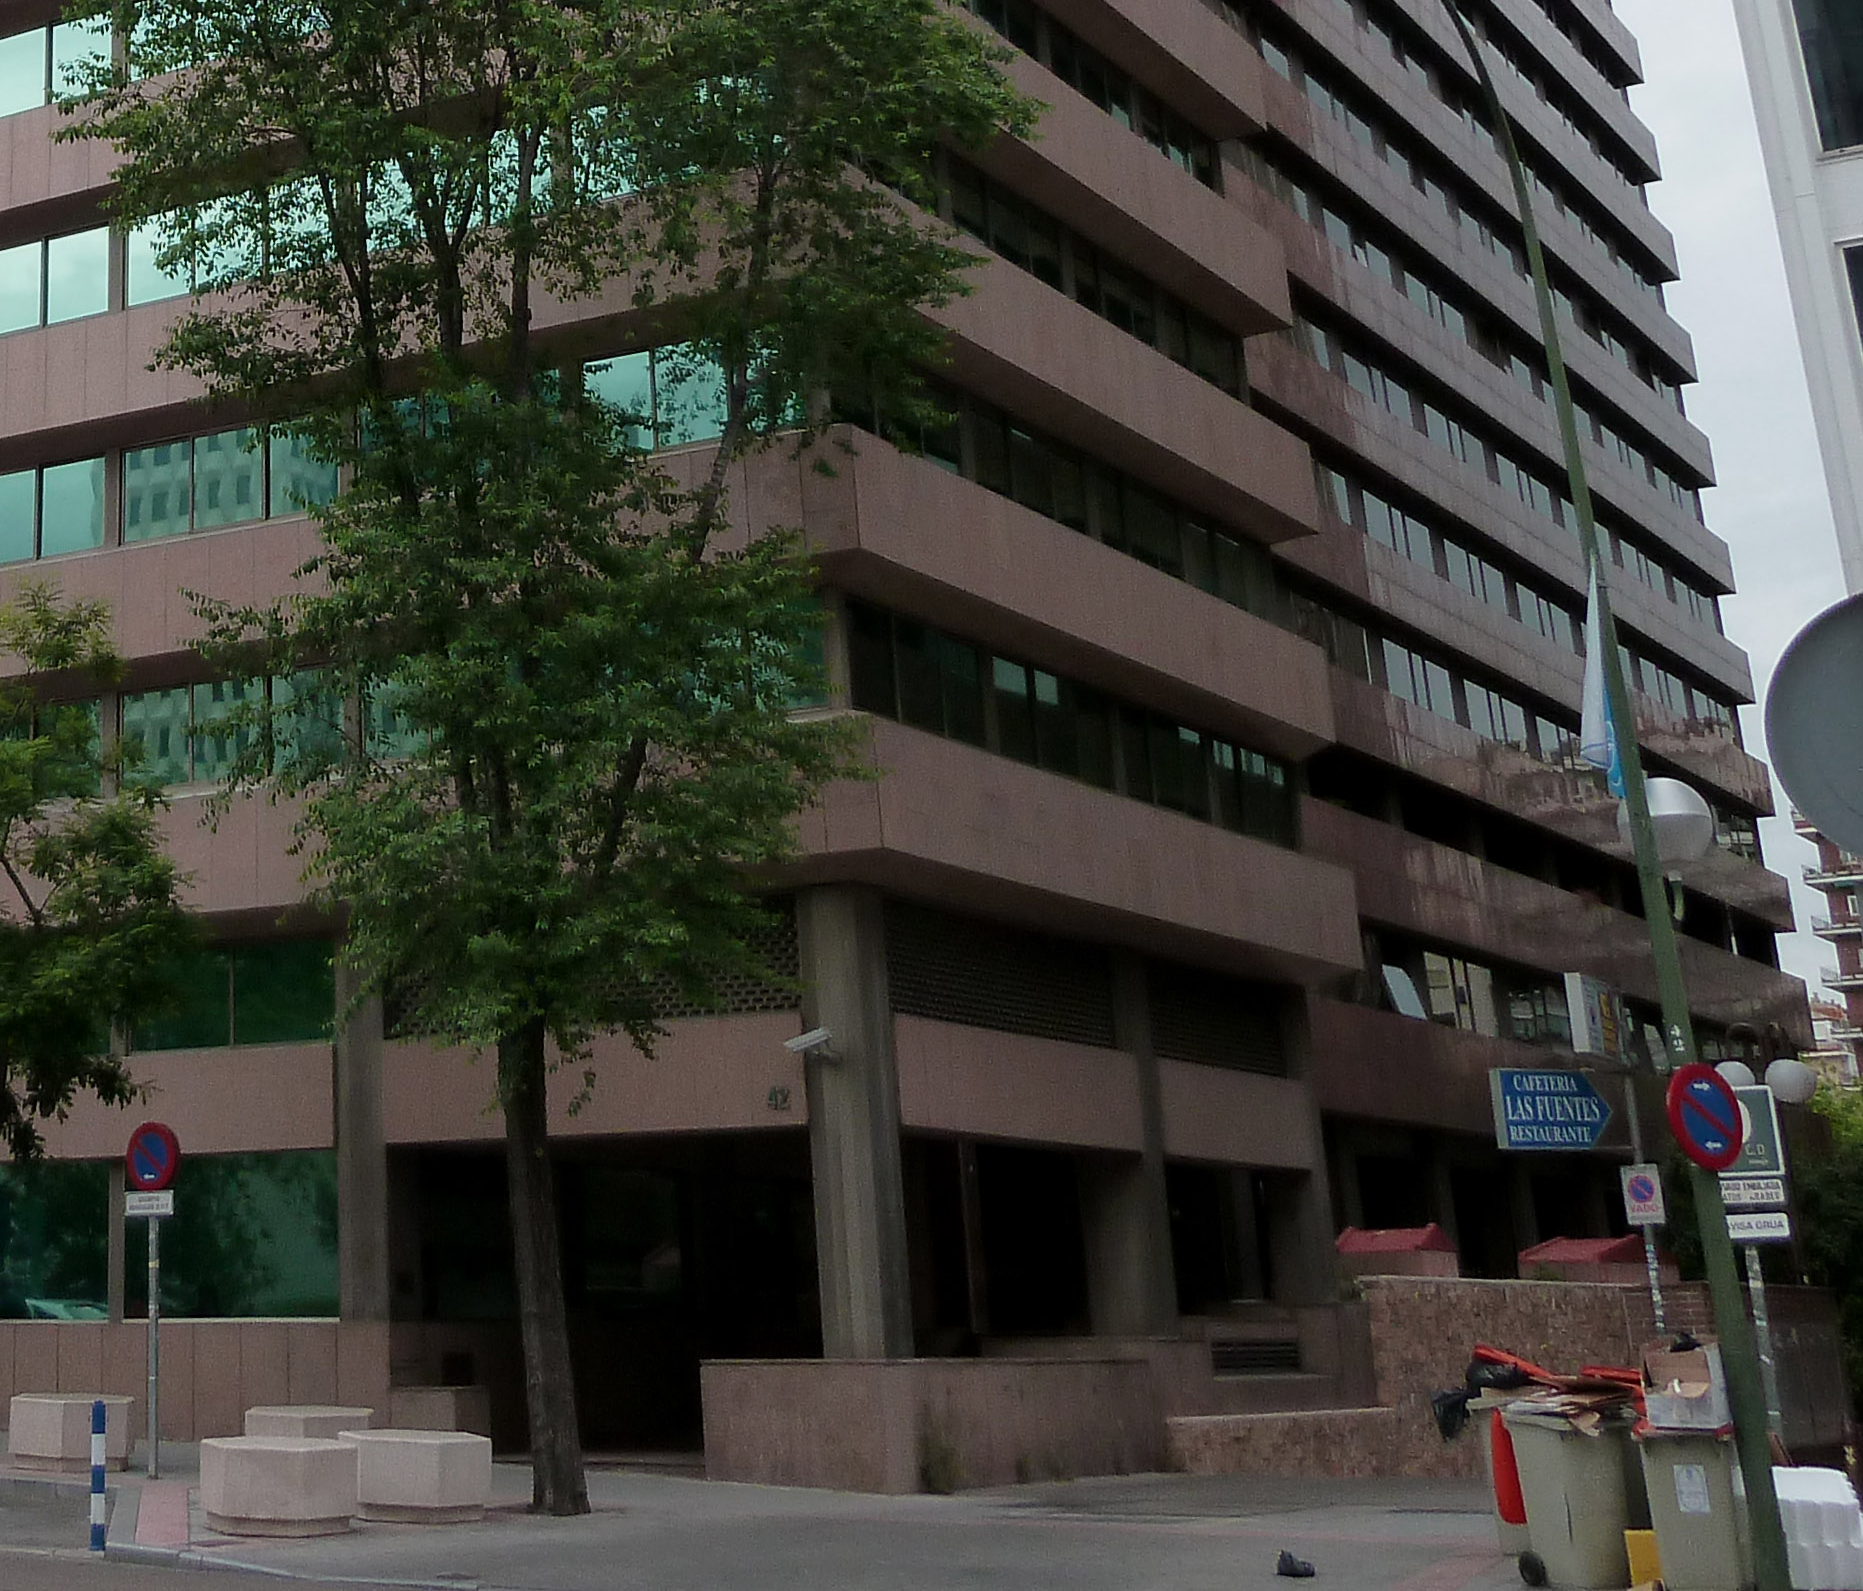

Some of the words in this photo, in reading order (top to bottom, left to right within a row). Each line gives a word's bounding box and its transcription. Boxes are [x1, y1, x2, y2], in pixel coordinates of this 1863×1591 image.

[1512, 1074, 1578, 1091] CAFETERIA
[767, 1085, 792, 1111] 42
[1505, 1095, 1534, 1121] LAS
[1536, 1096, 1600, 1122] FUENTES
[1509, 1125, 1592, 1142] RESTAURANTE
[1631, 1203, 1660, 1214] VADO
